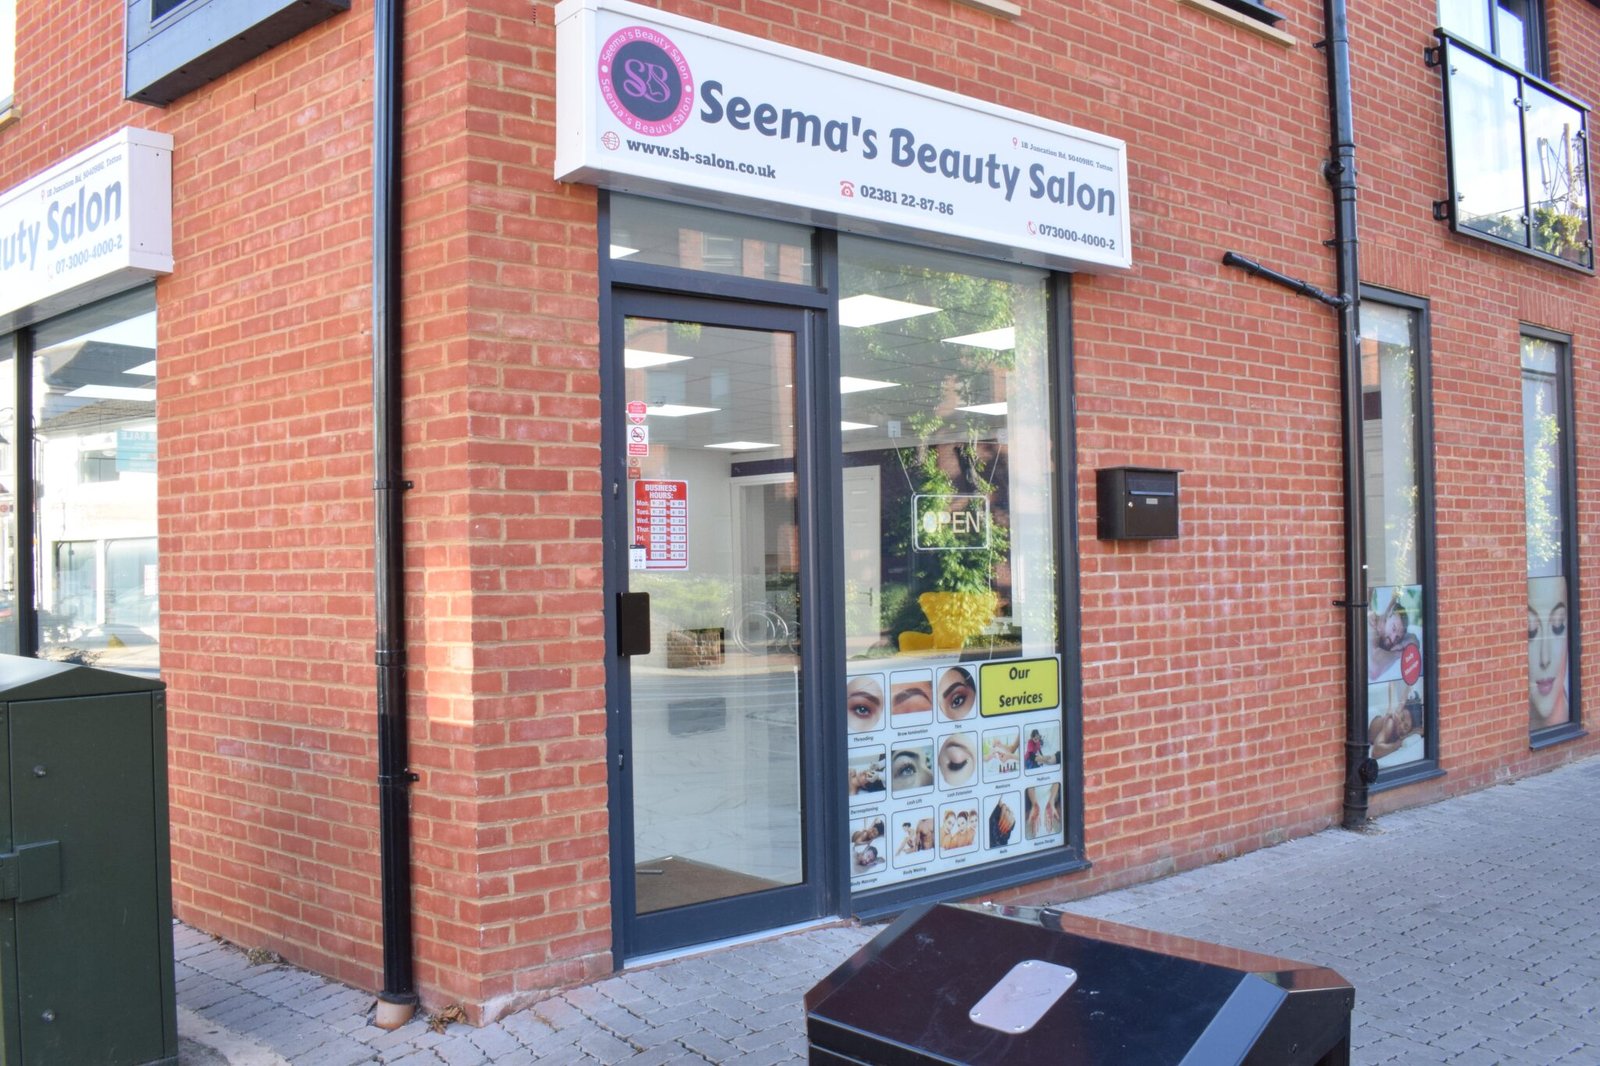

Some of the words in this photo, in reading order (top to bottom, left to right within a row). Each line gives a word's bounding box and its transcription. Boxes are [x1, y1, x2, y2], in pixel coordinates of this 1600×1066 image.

[602, 30, 634, 63] Seema's
[634, 28, 671, 51] Beauty
[671, 48, 690, 80] Salon
[601, 78, 633, 126] Seema's
[634, 121, 673, 134] Beauty
[673, 96, 691, 125] Salon
[626, 137, 777, 179] www.sb-salon.co.uk
[700, 80, 878, 160] Seema's
[889, 128, 1020, 202] Beauty
[1029, 163, 1115, 216] Salon
[860, 185, 897, 204] 02381
[901, 193, 954, 215] 22-87-86
[0, 218, 41, 271] uty
[47, 180, 122, 251] Salon
[1039, 223, 1115, 250] 073000-4000-2
[55, 233, 123, 275] 07-3000-4000-2
[645, 484, 677, 492] BUSINESS
[649, 492, 674, 500] HOURS:
[922, 510, 980, 533] OPEN
[1009, 666, 1031, 681] Our
[999, 691, 1043, 708] Services
